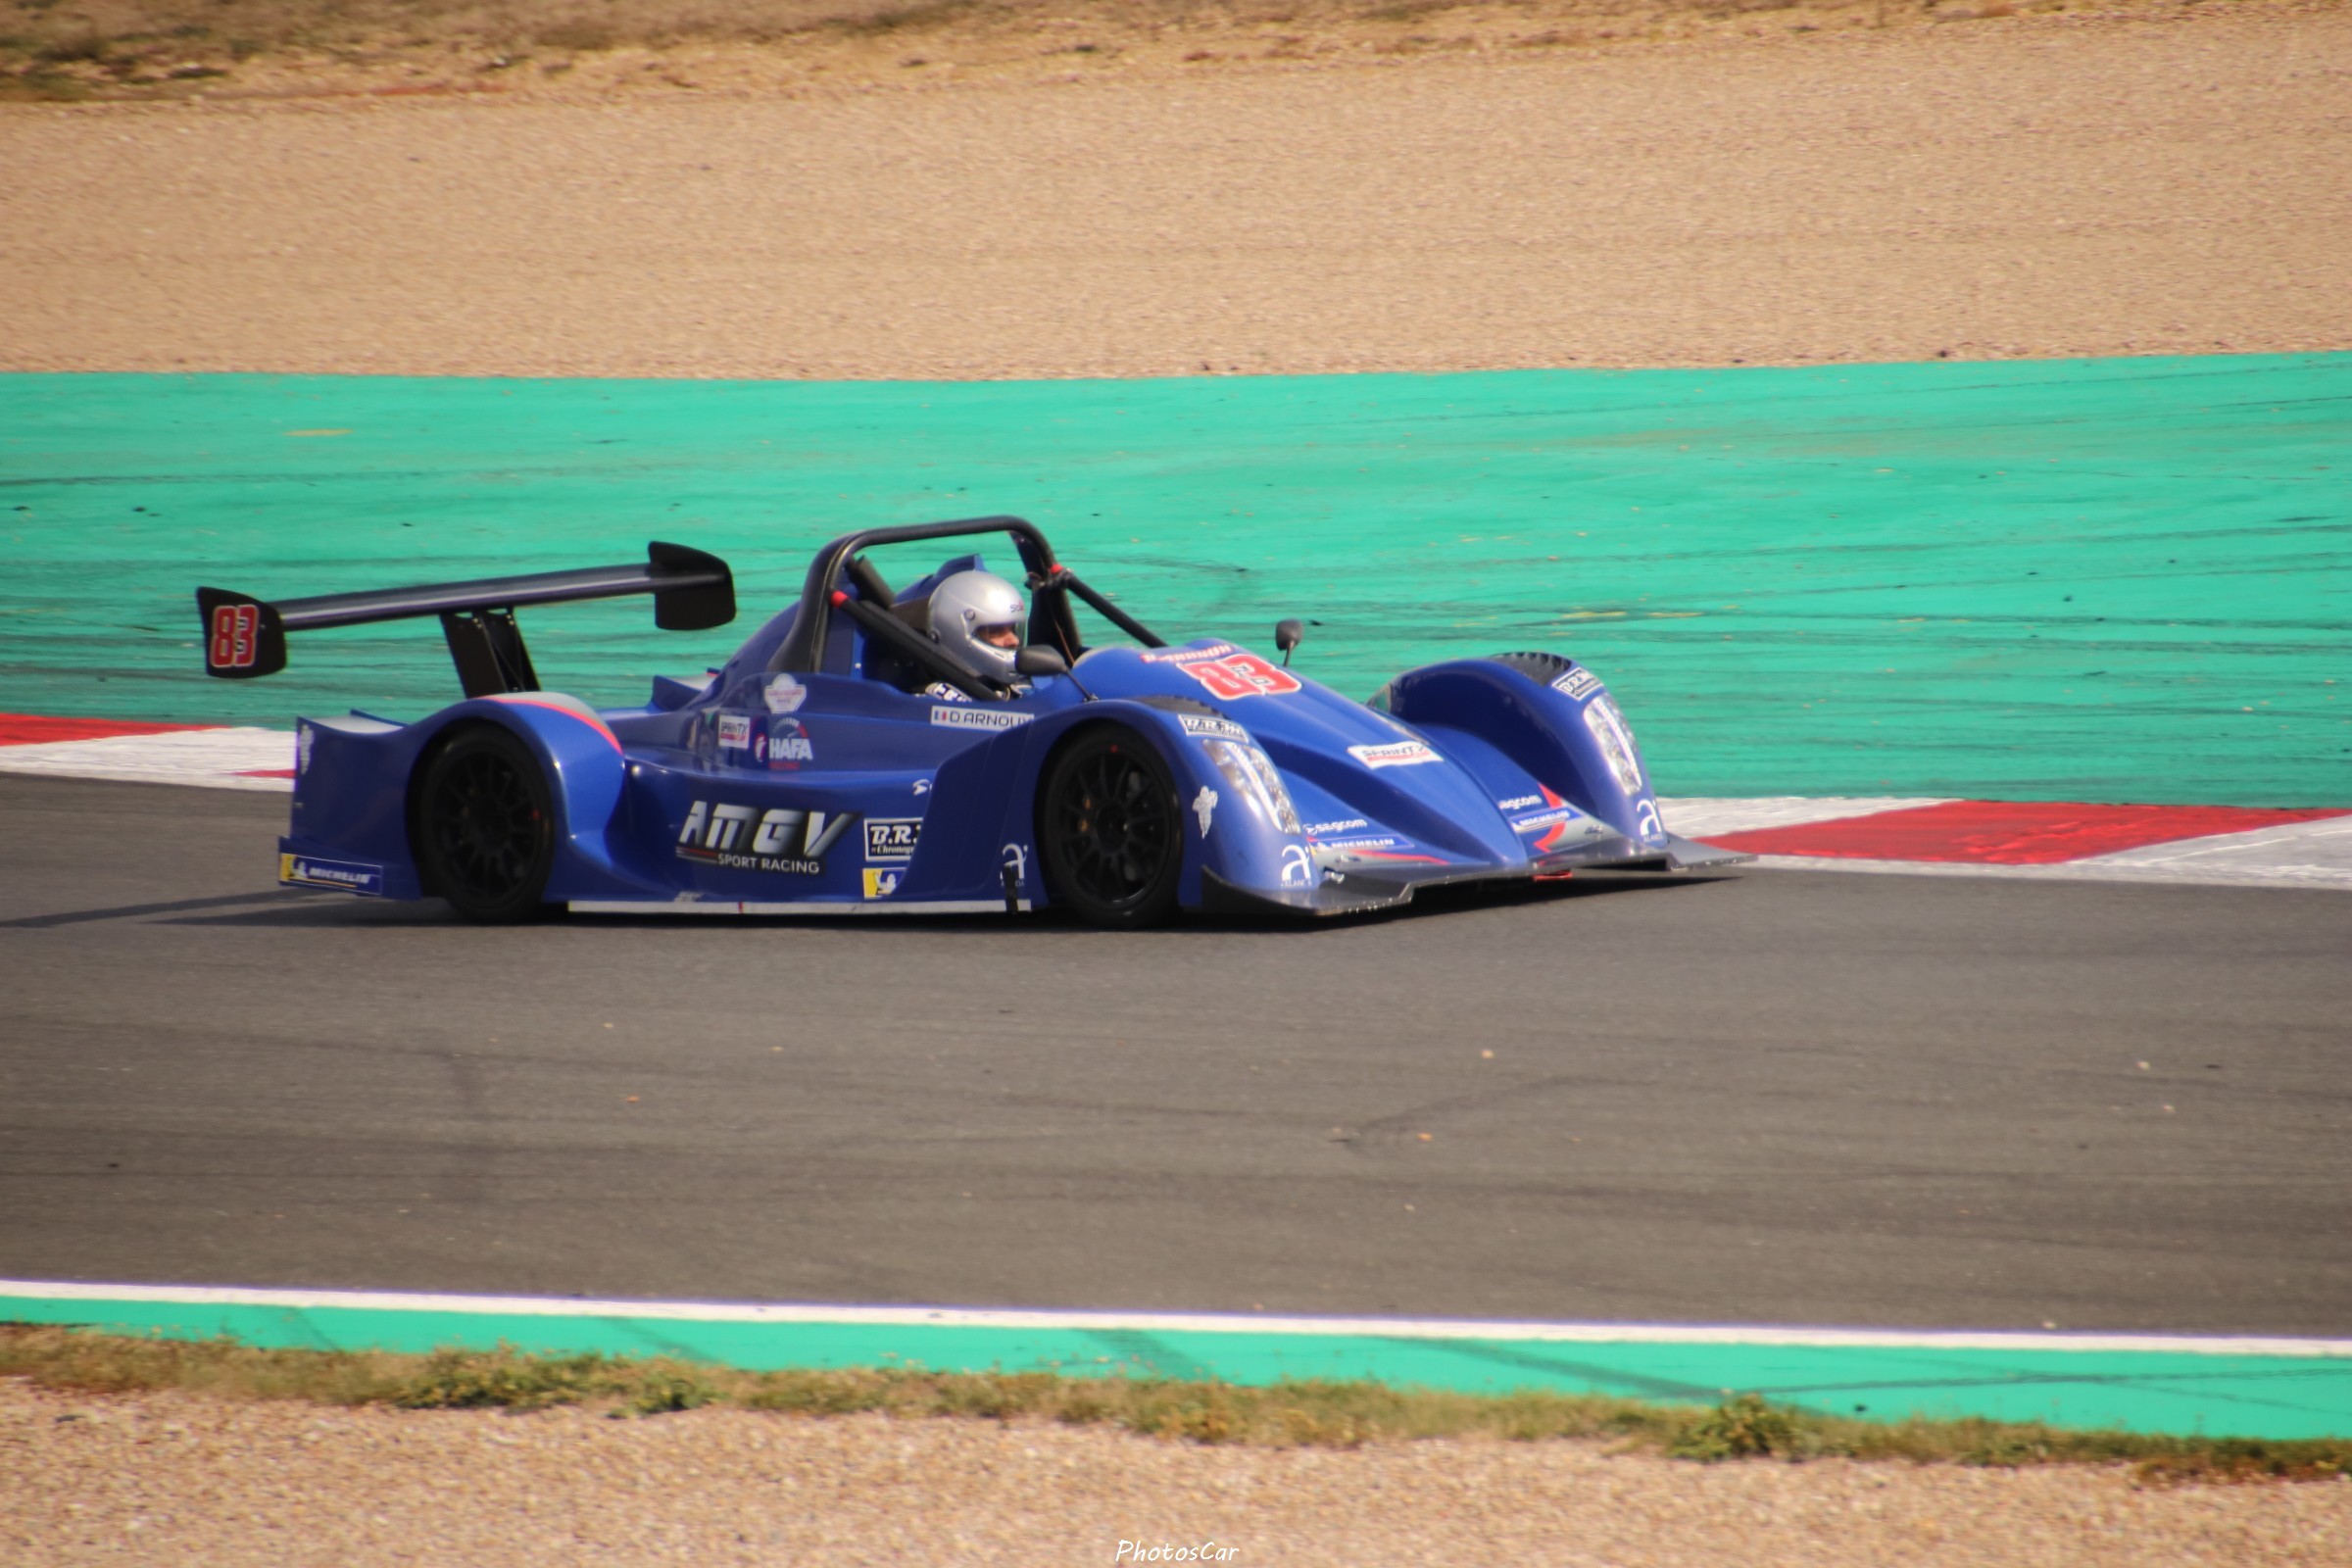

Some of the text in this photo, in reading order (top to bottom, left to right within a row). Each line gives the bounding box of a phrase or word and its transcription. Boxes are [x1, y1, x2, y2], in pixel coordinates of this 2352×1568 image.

[210, 604, 259, 667] 83
[1175, 654, 1302, 700] 83
[769, 738, 813, 760] HAFA
[718, 852, 820, 874] SPORT RACING
[309, 867, 370, 884] MICHELIN
